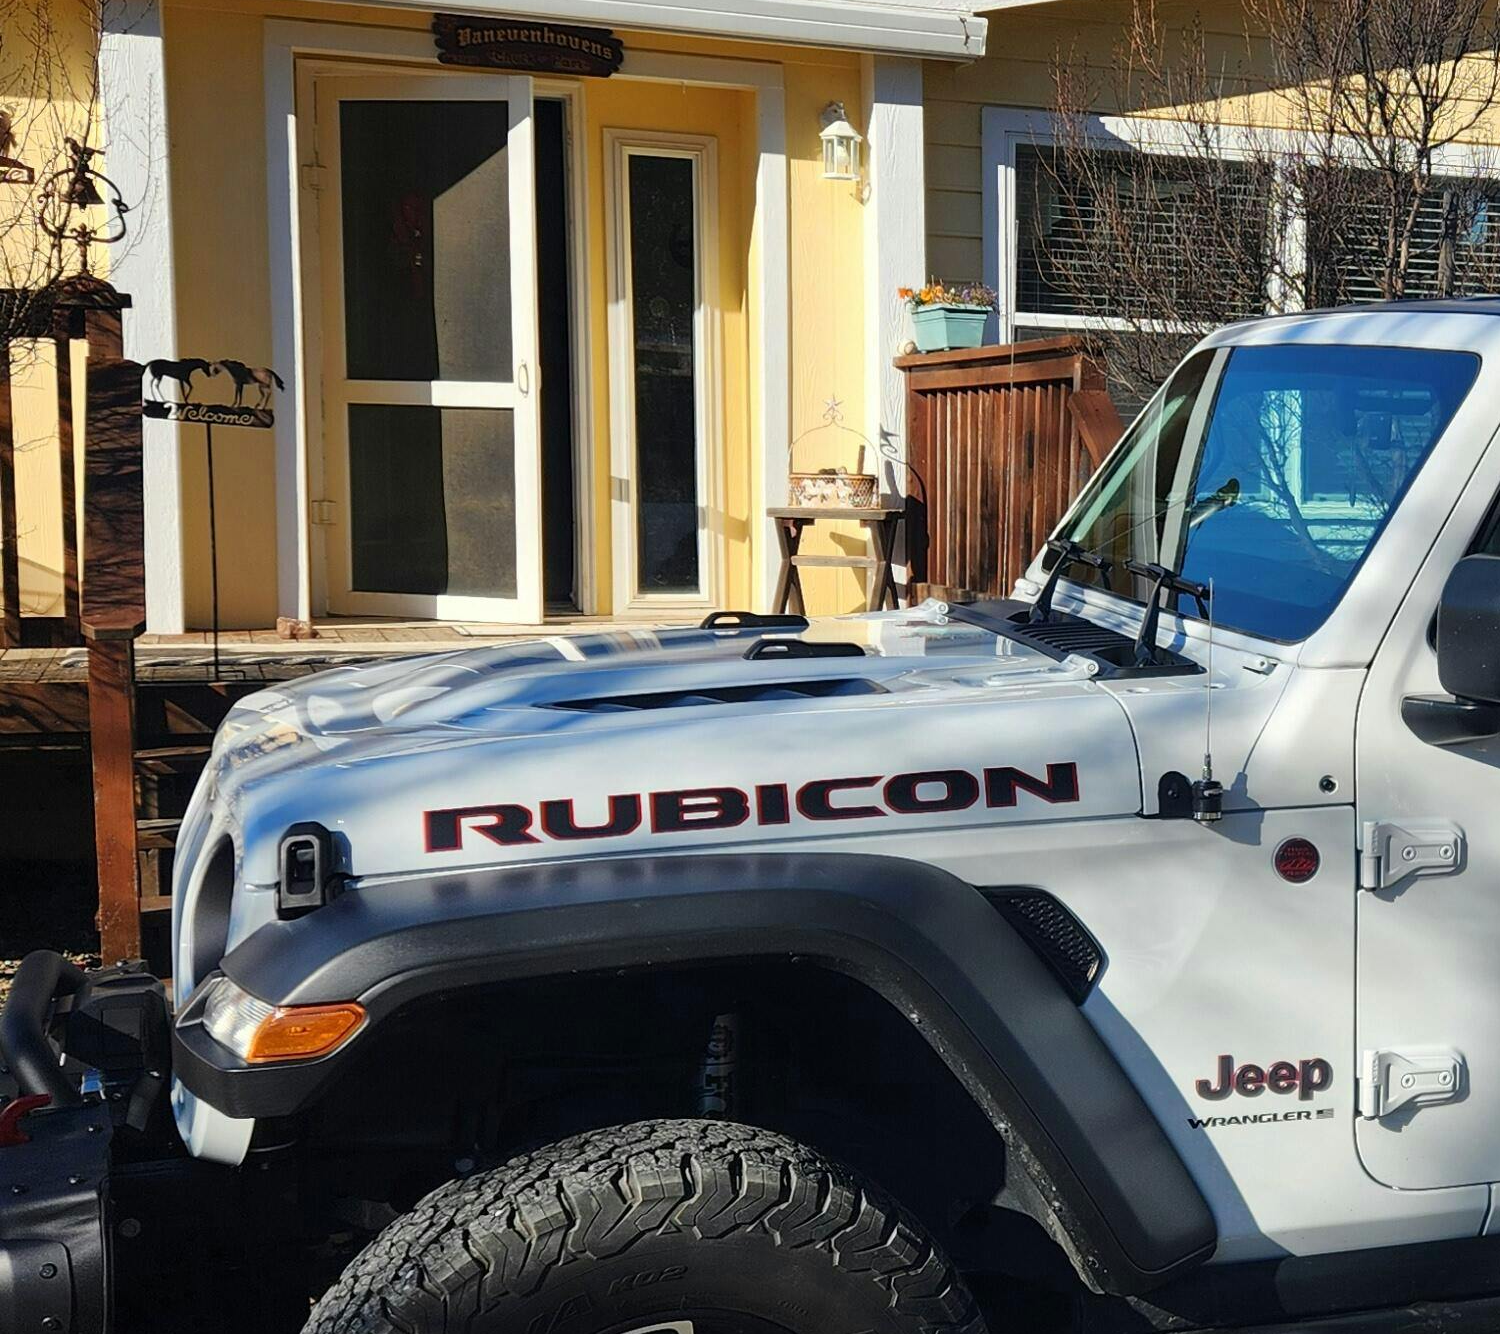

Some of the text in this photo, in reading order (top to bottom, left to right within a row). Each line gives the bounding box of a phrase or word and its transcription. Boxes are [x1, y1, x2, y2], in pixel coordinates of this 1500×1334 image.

[163, 402, 254, 425] Welcome
[423, 762, 1080, 854] RUBICON
[1195, 1054, 1334, 1101] Jeep
[1186, 1110, 1312, 1129] WRANGLER
[608, 1266, 688, 1296] KO2
